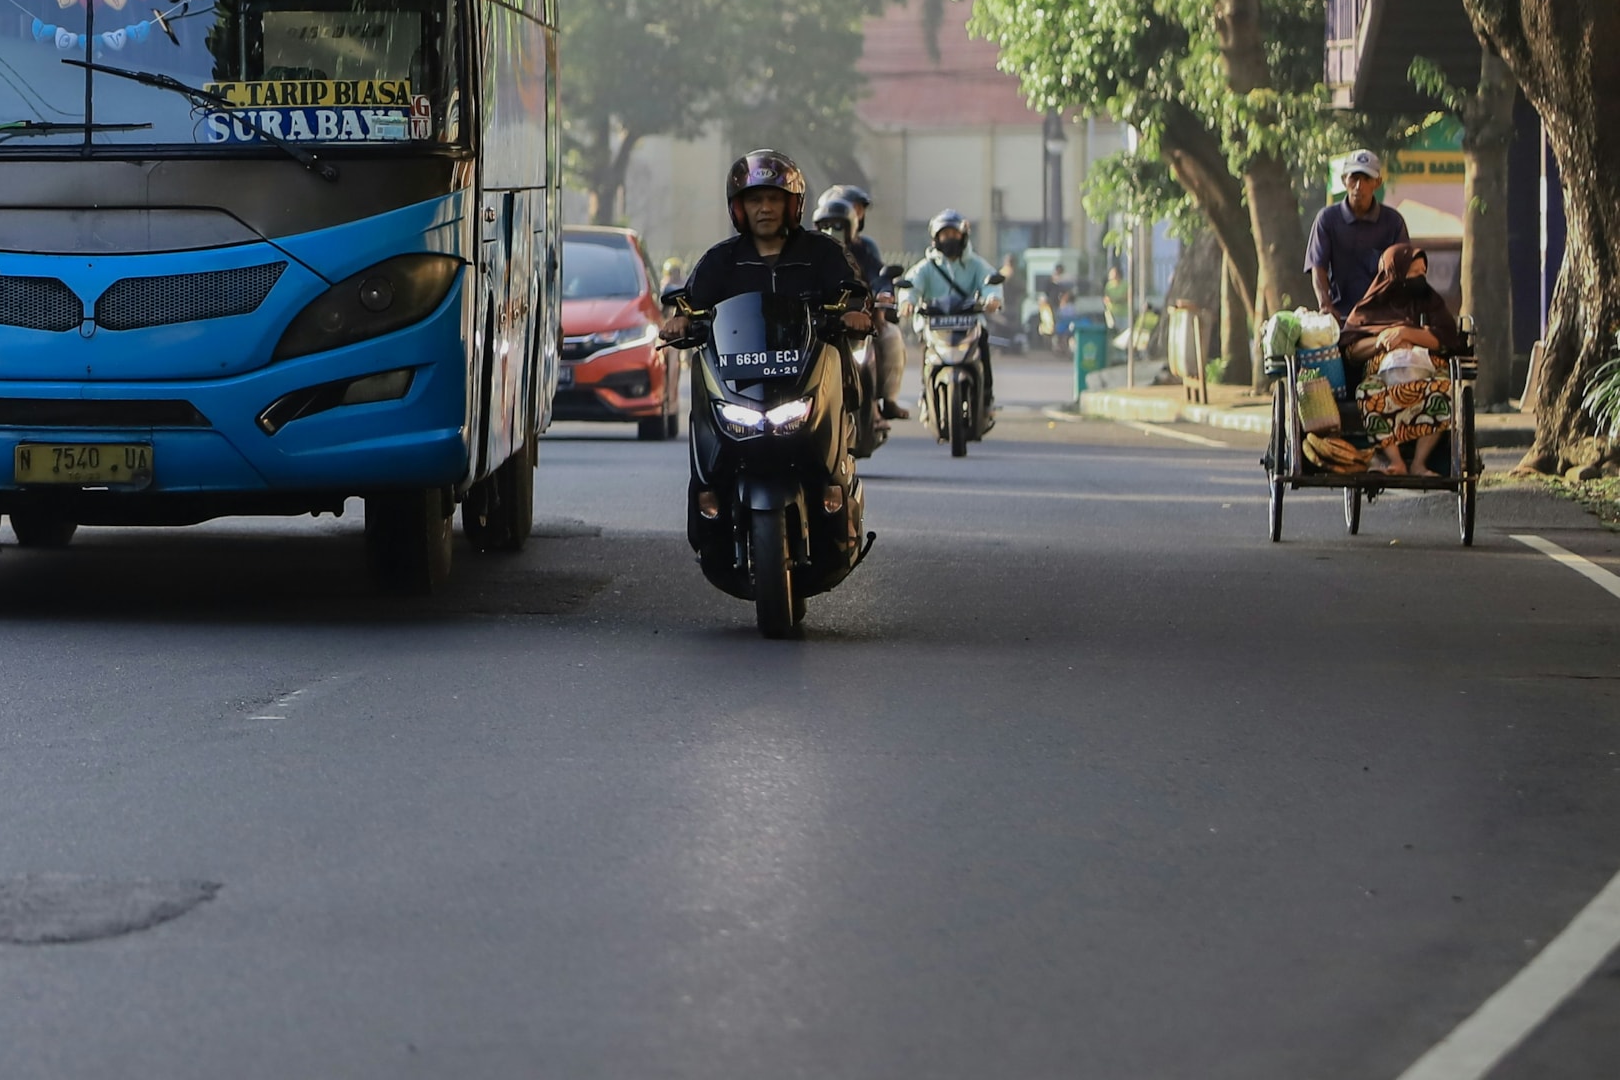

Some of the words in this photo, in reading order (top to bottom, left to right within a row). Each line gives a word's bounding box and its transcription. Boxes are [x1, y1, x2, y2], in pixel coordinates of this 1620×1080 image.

[246, 82, 328, 107] TARIP
[333, 81, 409, 106] BIASA
[719, 355, 728, 367] N
[736, 352, 767, 366] 6630
[776, 350, 799, 363] ECJ
[20, 449, 30, 470] N
[52, 448, 100, 469] 7540
[125, 448, 147, 469] UA
